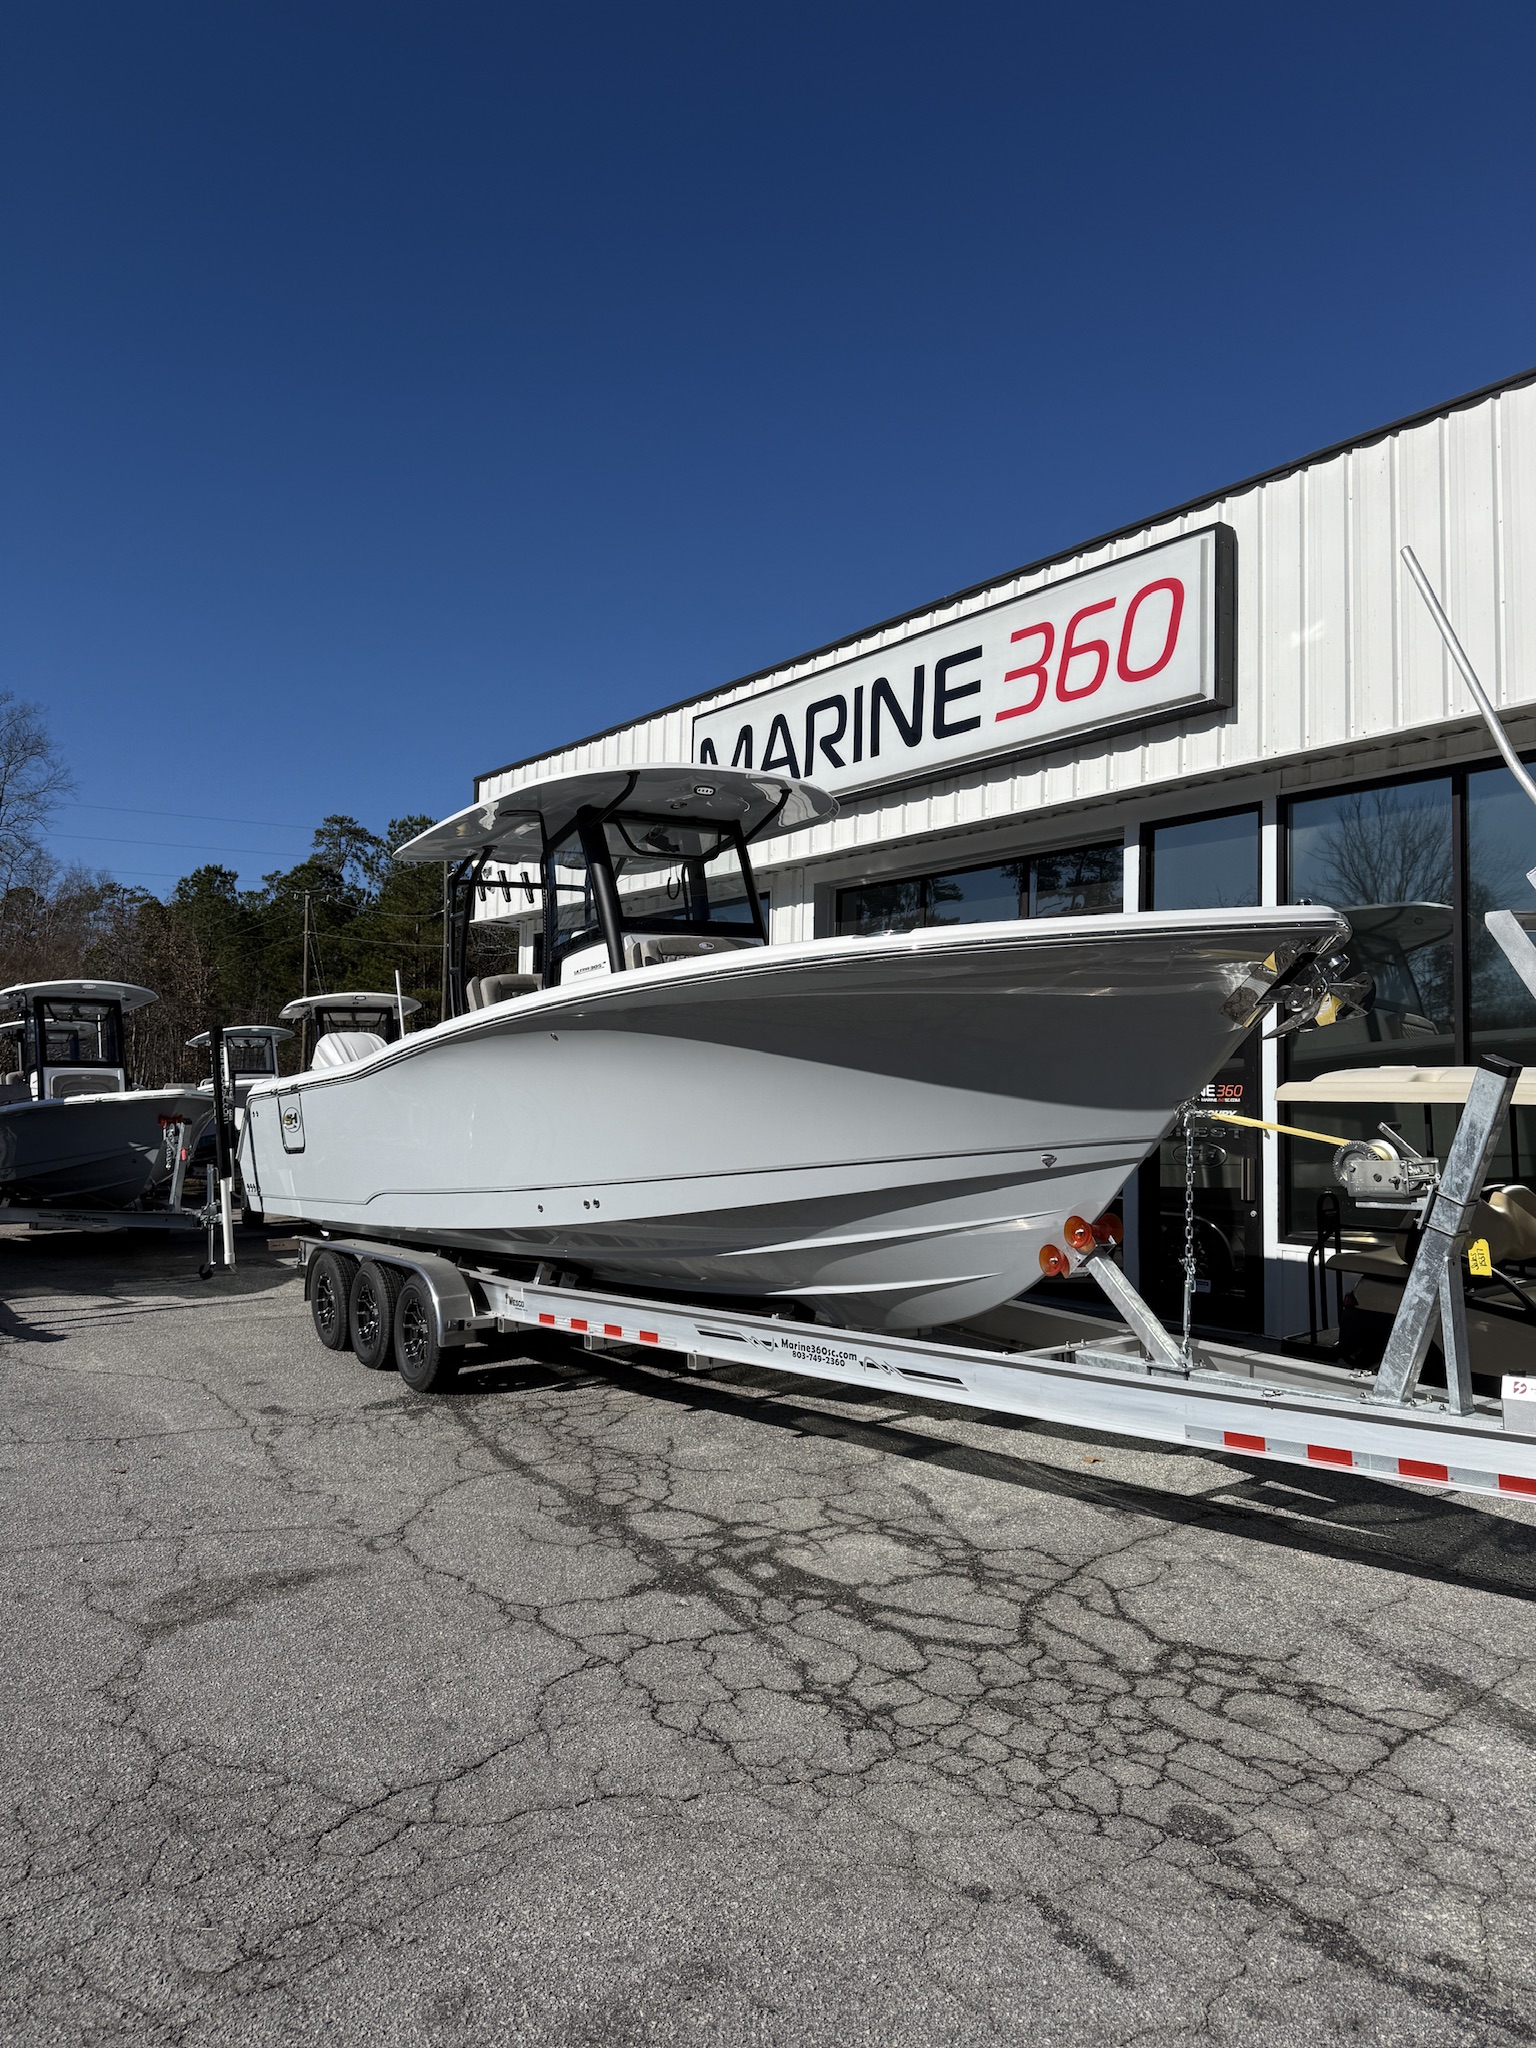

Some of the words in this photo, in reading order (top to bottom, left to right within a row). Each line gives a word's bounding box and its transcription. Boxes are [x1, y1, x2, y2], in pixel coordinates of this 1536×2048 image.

[995, 577, 1185, 723] 360
[1216, 1084, 1244, 1098] 360
[781, 1338, 858, 1361] Marine360sc.com
[792, 1350, 846, 1367] 803-749-2360
